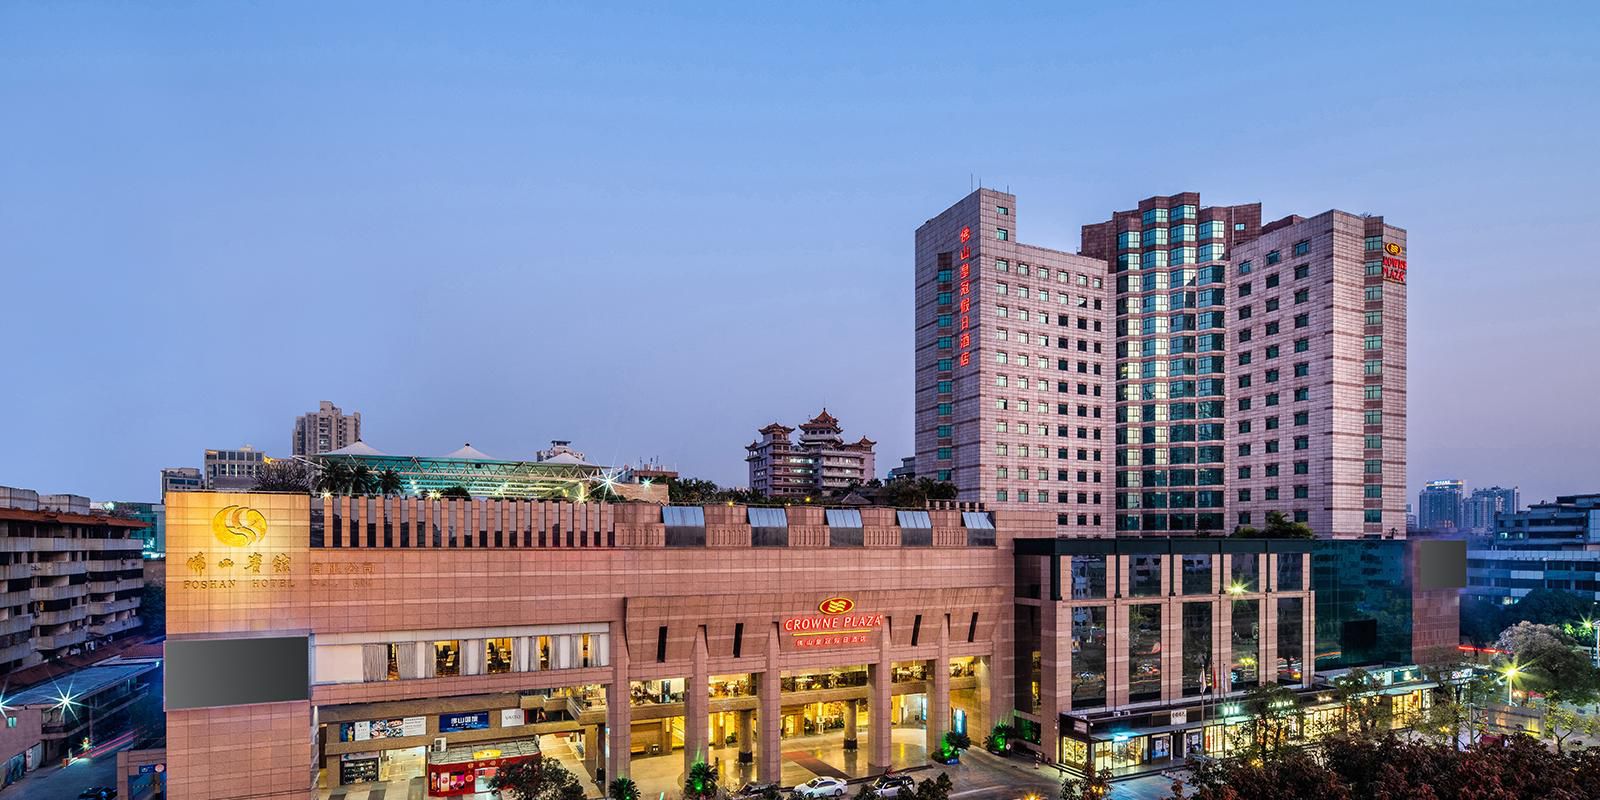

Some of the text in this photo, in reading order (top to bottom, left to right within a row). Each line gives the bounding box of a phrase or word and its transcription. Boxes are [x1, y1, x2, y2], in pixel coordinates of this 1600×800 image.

[960, 226, 970, 367] 佛山皇冠假日酒店
[183, 579, 296, 590] FOSHAN HOTEL
[785, 614, 881, 631] CROWNE PLAZA
